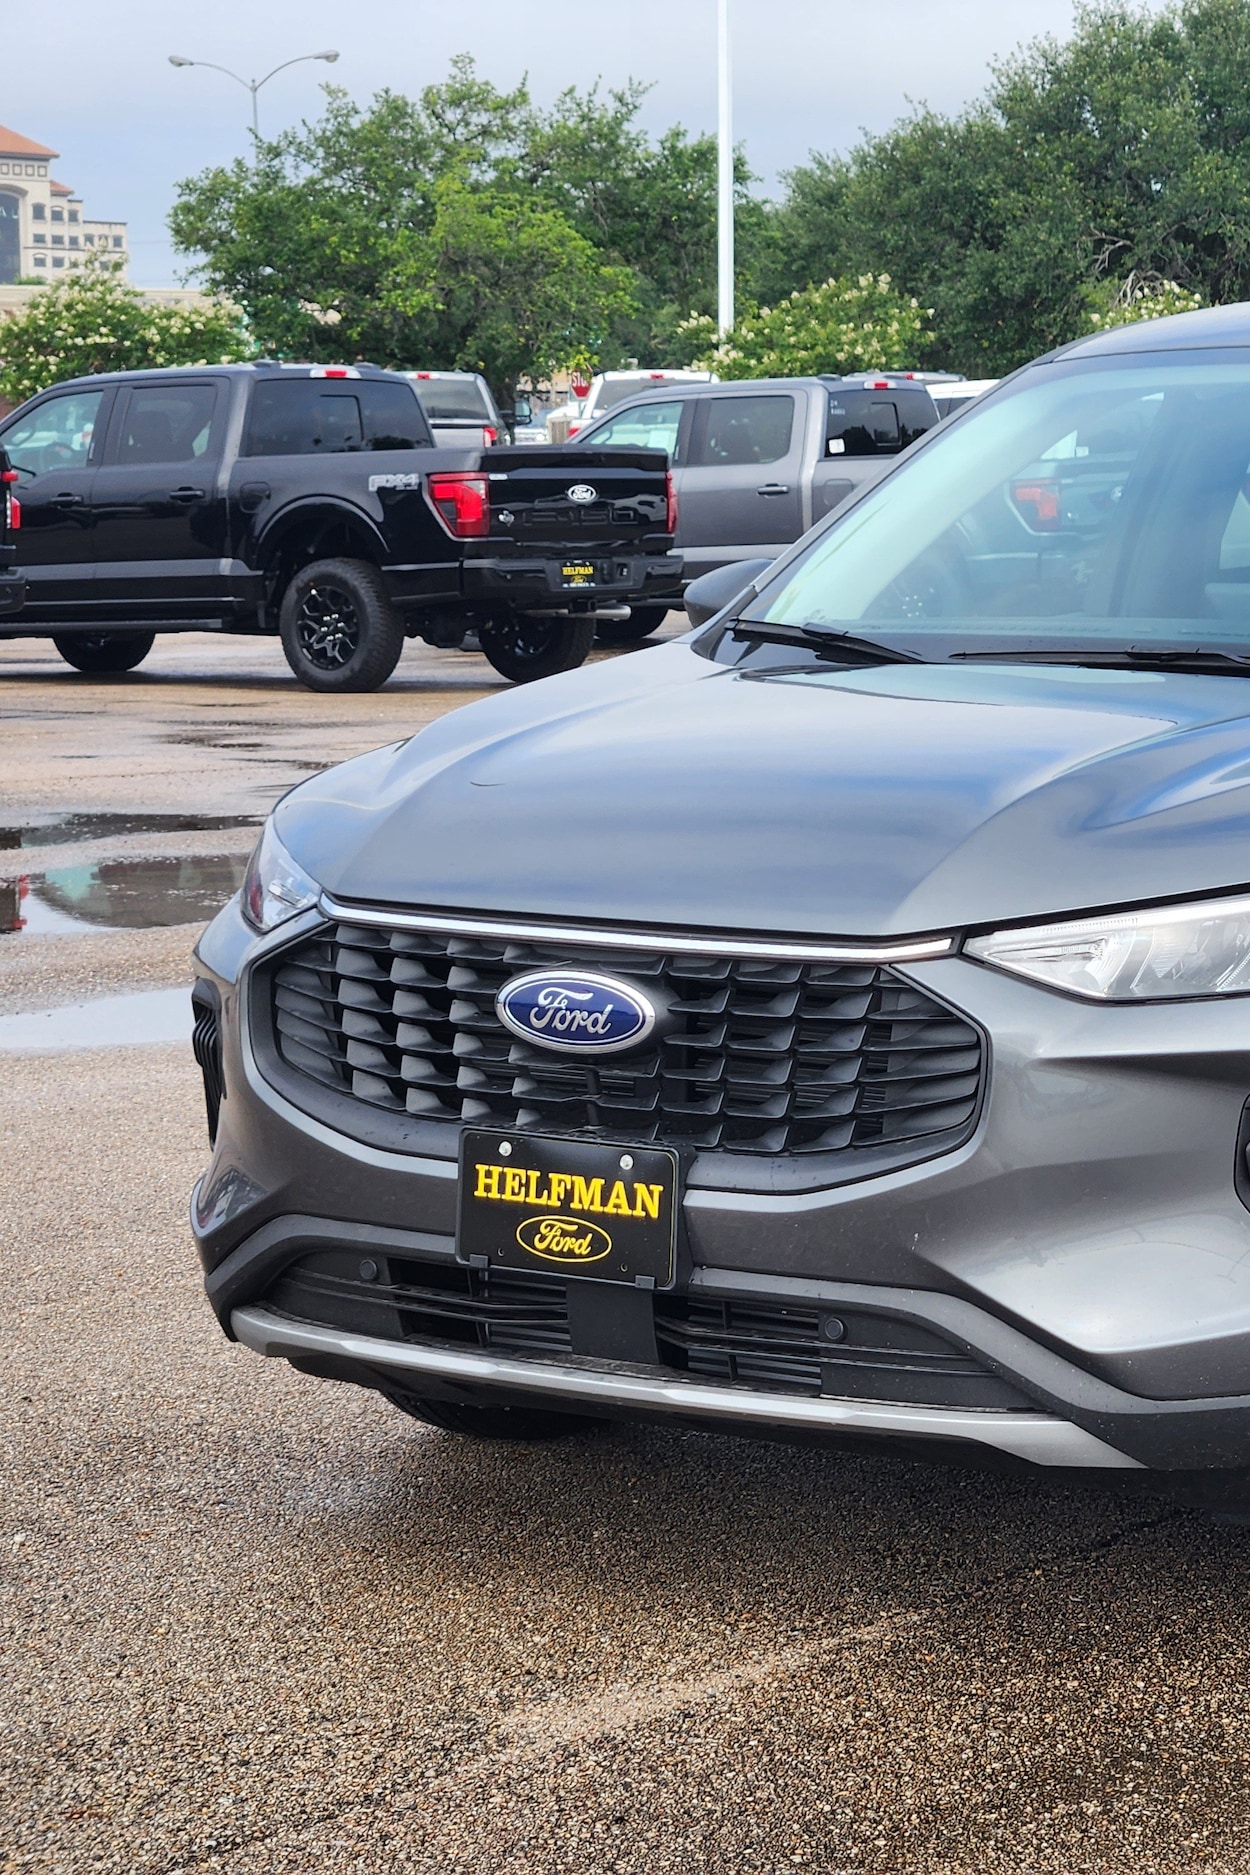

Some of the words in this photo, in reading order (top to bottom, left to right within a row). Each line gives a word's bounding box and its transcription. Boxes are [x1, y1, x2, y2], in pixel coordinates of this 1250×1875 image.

[572, 371, 589, 388] STO
[368, 473, 420, 491] FX4
[529, 986, 614, 1035] Ford
[473, 1163, 664, 1219] HELFMAN
[533, 1219, 593, 1256] Ford
